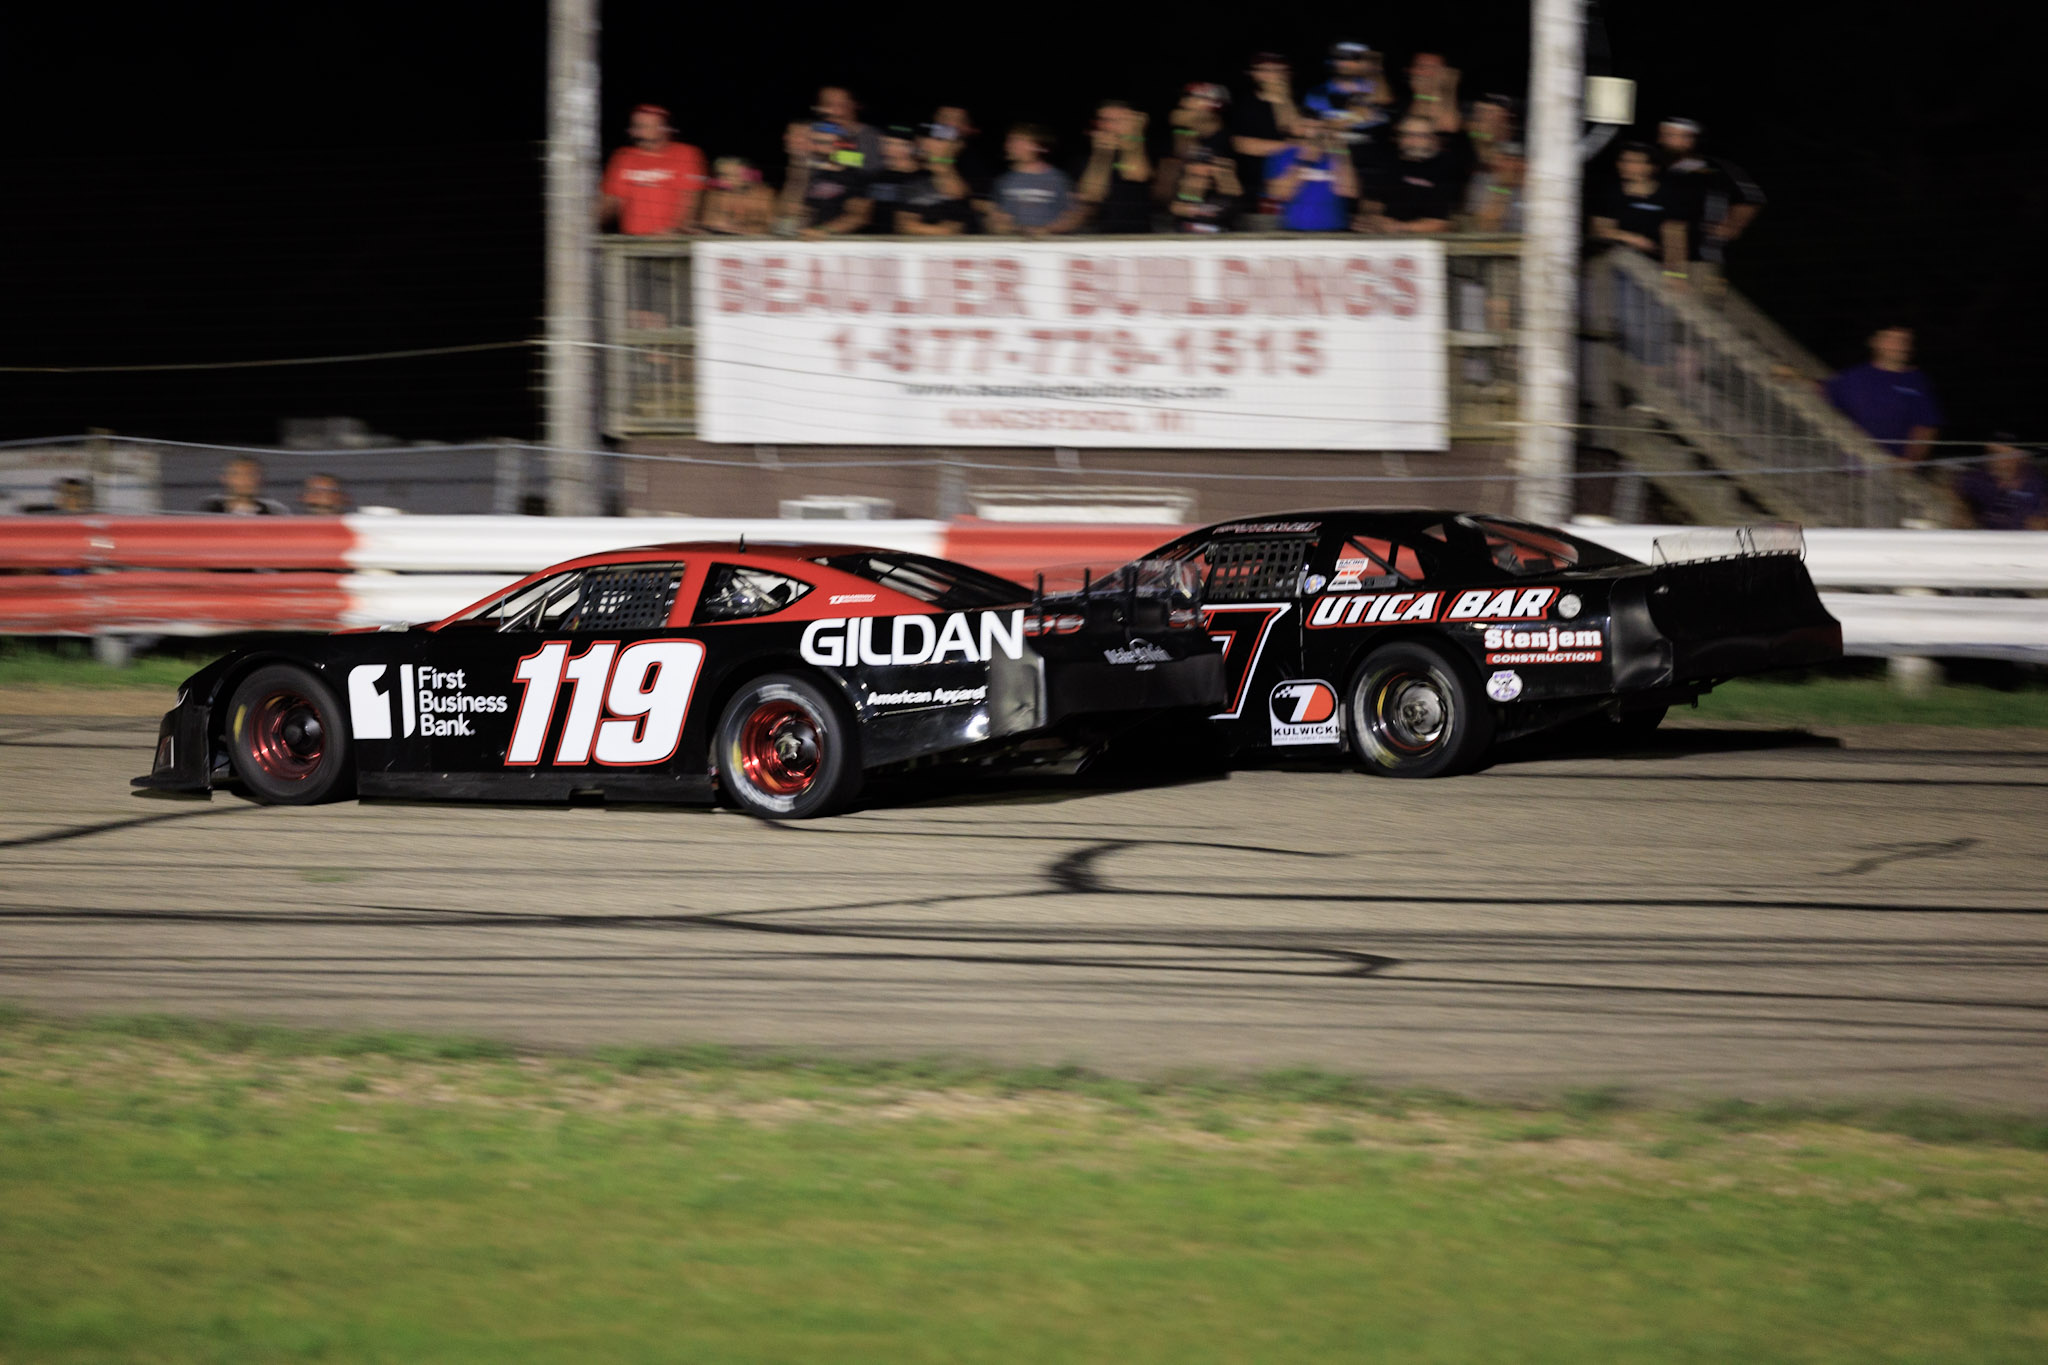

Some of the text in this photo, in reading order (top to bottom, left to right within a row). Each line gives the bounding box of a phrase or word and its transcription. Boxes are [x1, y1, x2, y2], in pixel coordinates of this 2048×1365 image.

[1064, 257, 1420, 317] BUILDINGS
[1307, 586, 1559, 629] UTICA BAR
[799, 609, 1025, 667] GILDAN
[1484, 627, 1603, 651] Stenjem
[1491, 651, 1596, 664] CONSTRUCTION
[418, 666, 467, 690] First
[419, 690, 508, 713] Business
[504, 638, 708, 767] 119
[866, 685, 988, 706] American Apparel
[1273, 725, 1341, 737] KULWICKI
